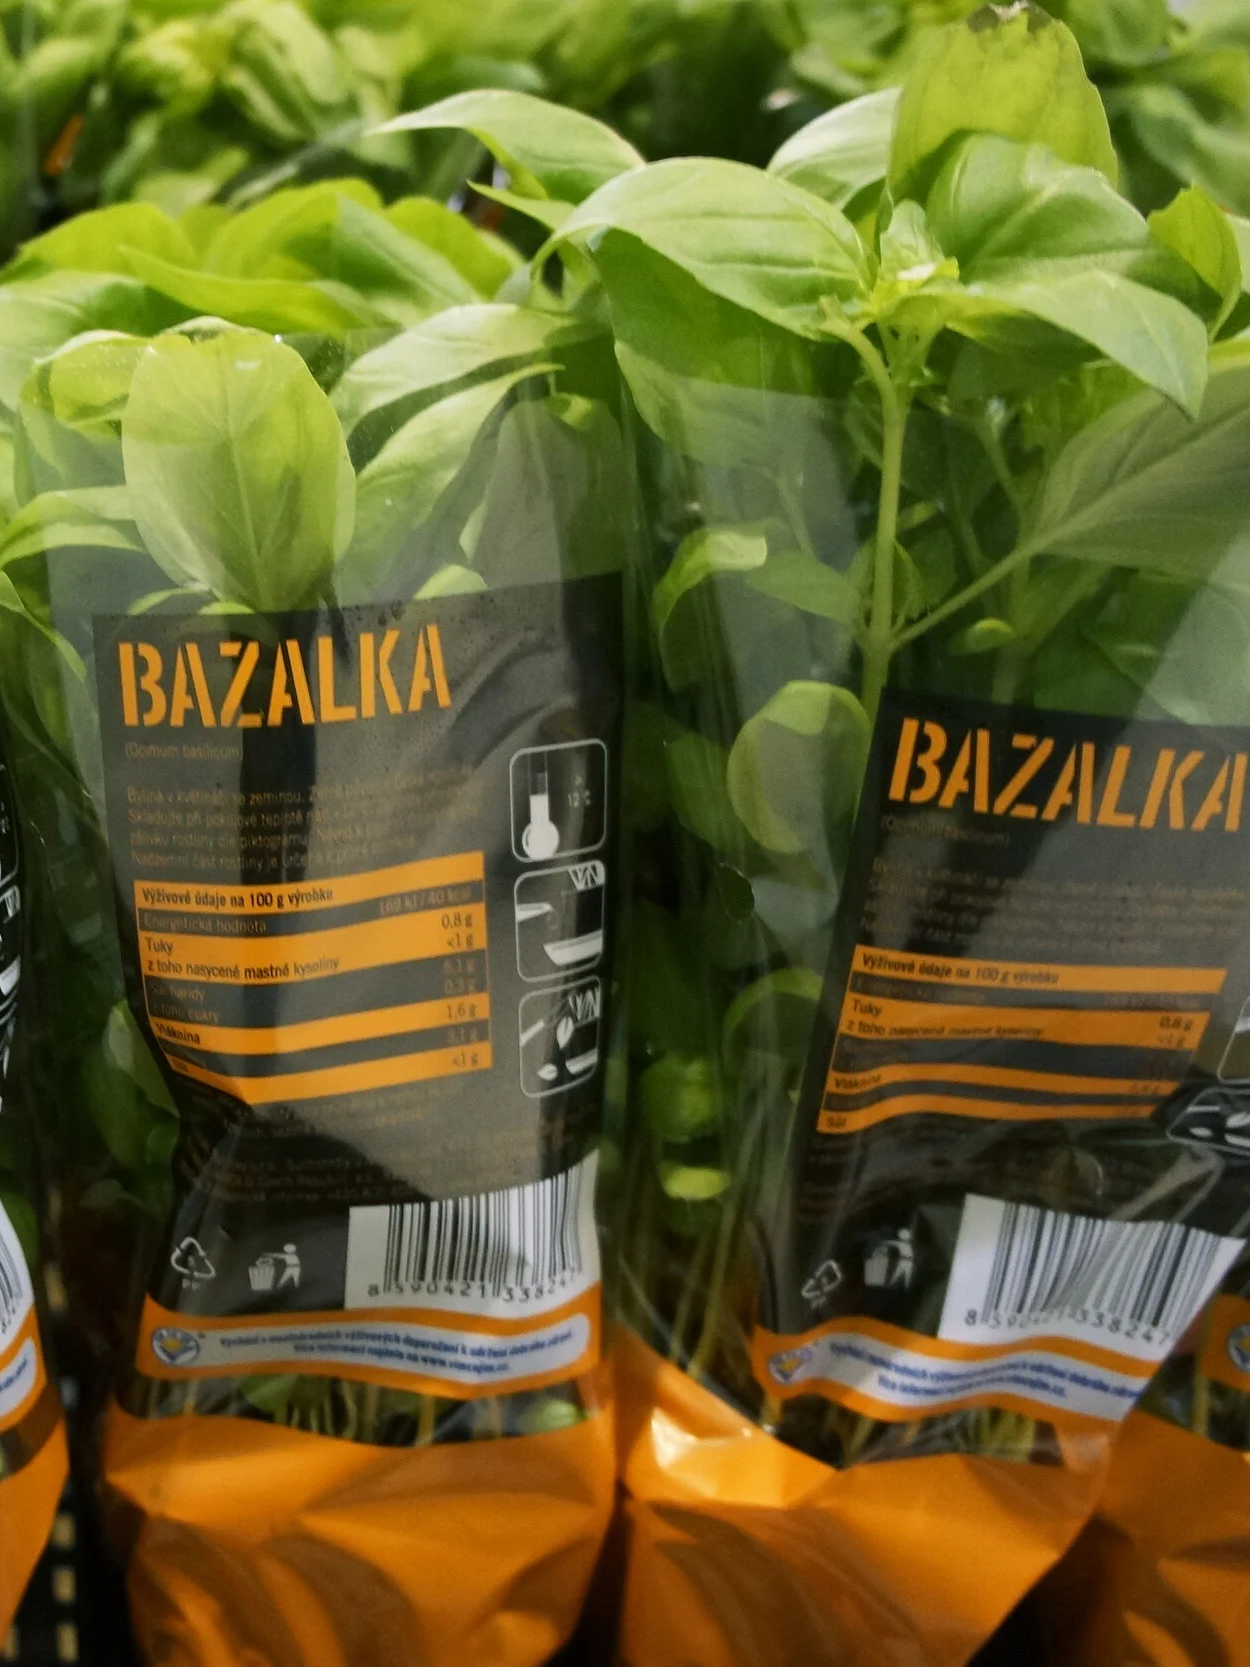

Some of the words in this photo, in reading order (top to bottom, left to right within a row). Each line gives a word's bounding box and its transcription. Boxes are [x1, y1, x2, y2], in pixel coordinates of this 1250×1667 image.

[118, 624, 452, 728] BAZALKA
[888, 717, 1248, 833] BAZALKA
[142, 886, 191, 904] Výživové
[195, 892, 226, 910] údaje
[230, 895, 245, 906] na
[250, 892, 273, 906] 100
[277, 895, 284, 908] g
[288, 887, 333, 908] výrobku
[146, 936, 173, 955] Tuky
[441, 912, 461, 930] 0,8
[465, 914, 473, 927] g
[147, 960, 153, 970] z
[157, 960, 182, 973] toho
[186, 963, 240, 981] nasycené
[244, 964, 289, 979] mastné
[294, 956, 339, 976] kyseliny
[447, 934, 461, 948] <1
[466, 934, 474, 948] g
[862, 953, 915, 970] Výživové
[446, 1002, 466, 1019] 1,6
[469, 1003, 477, 1018] g
[852, 1000, 882, 1017] Tuky
[470, 1052, 478, 1066] g
[965, 1309, 977, 1326] 8
